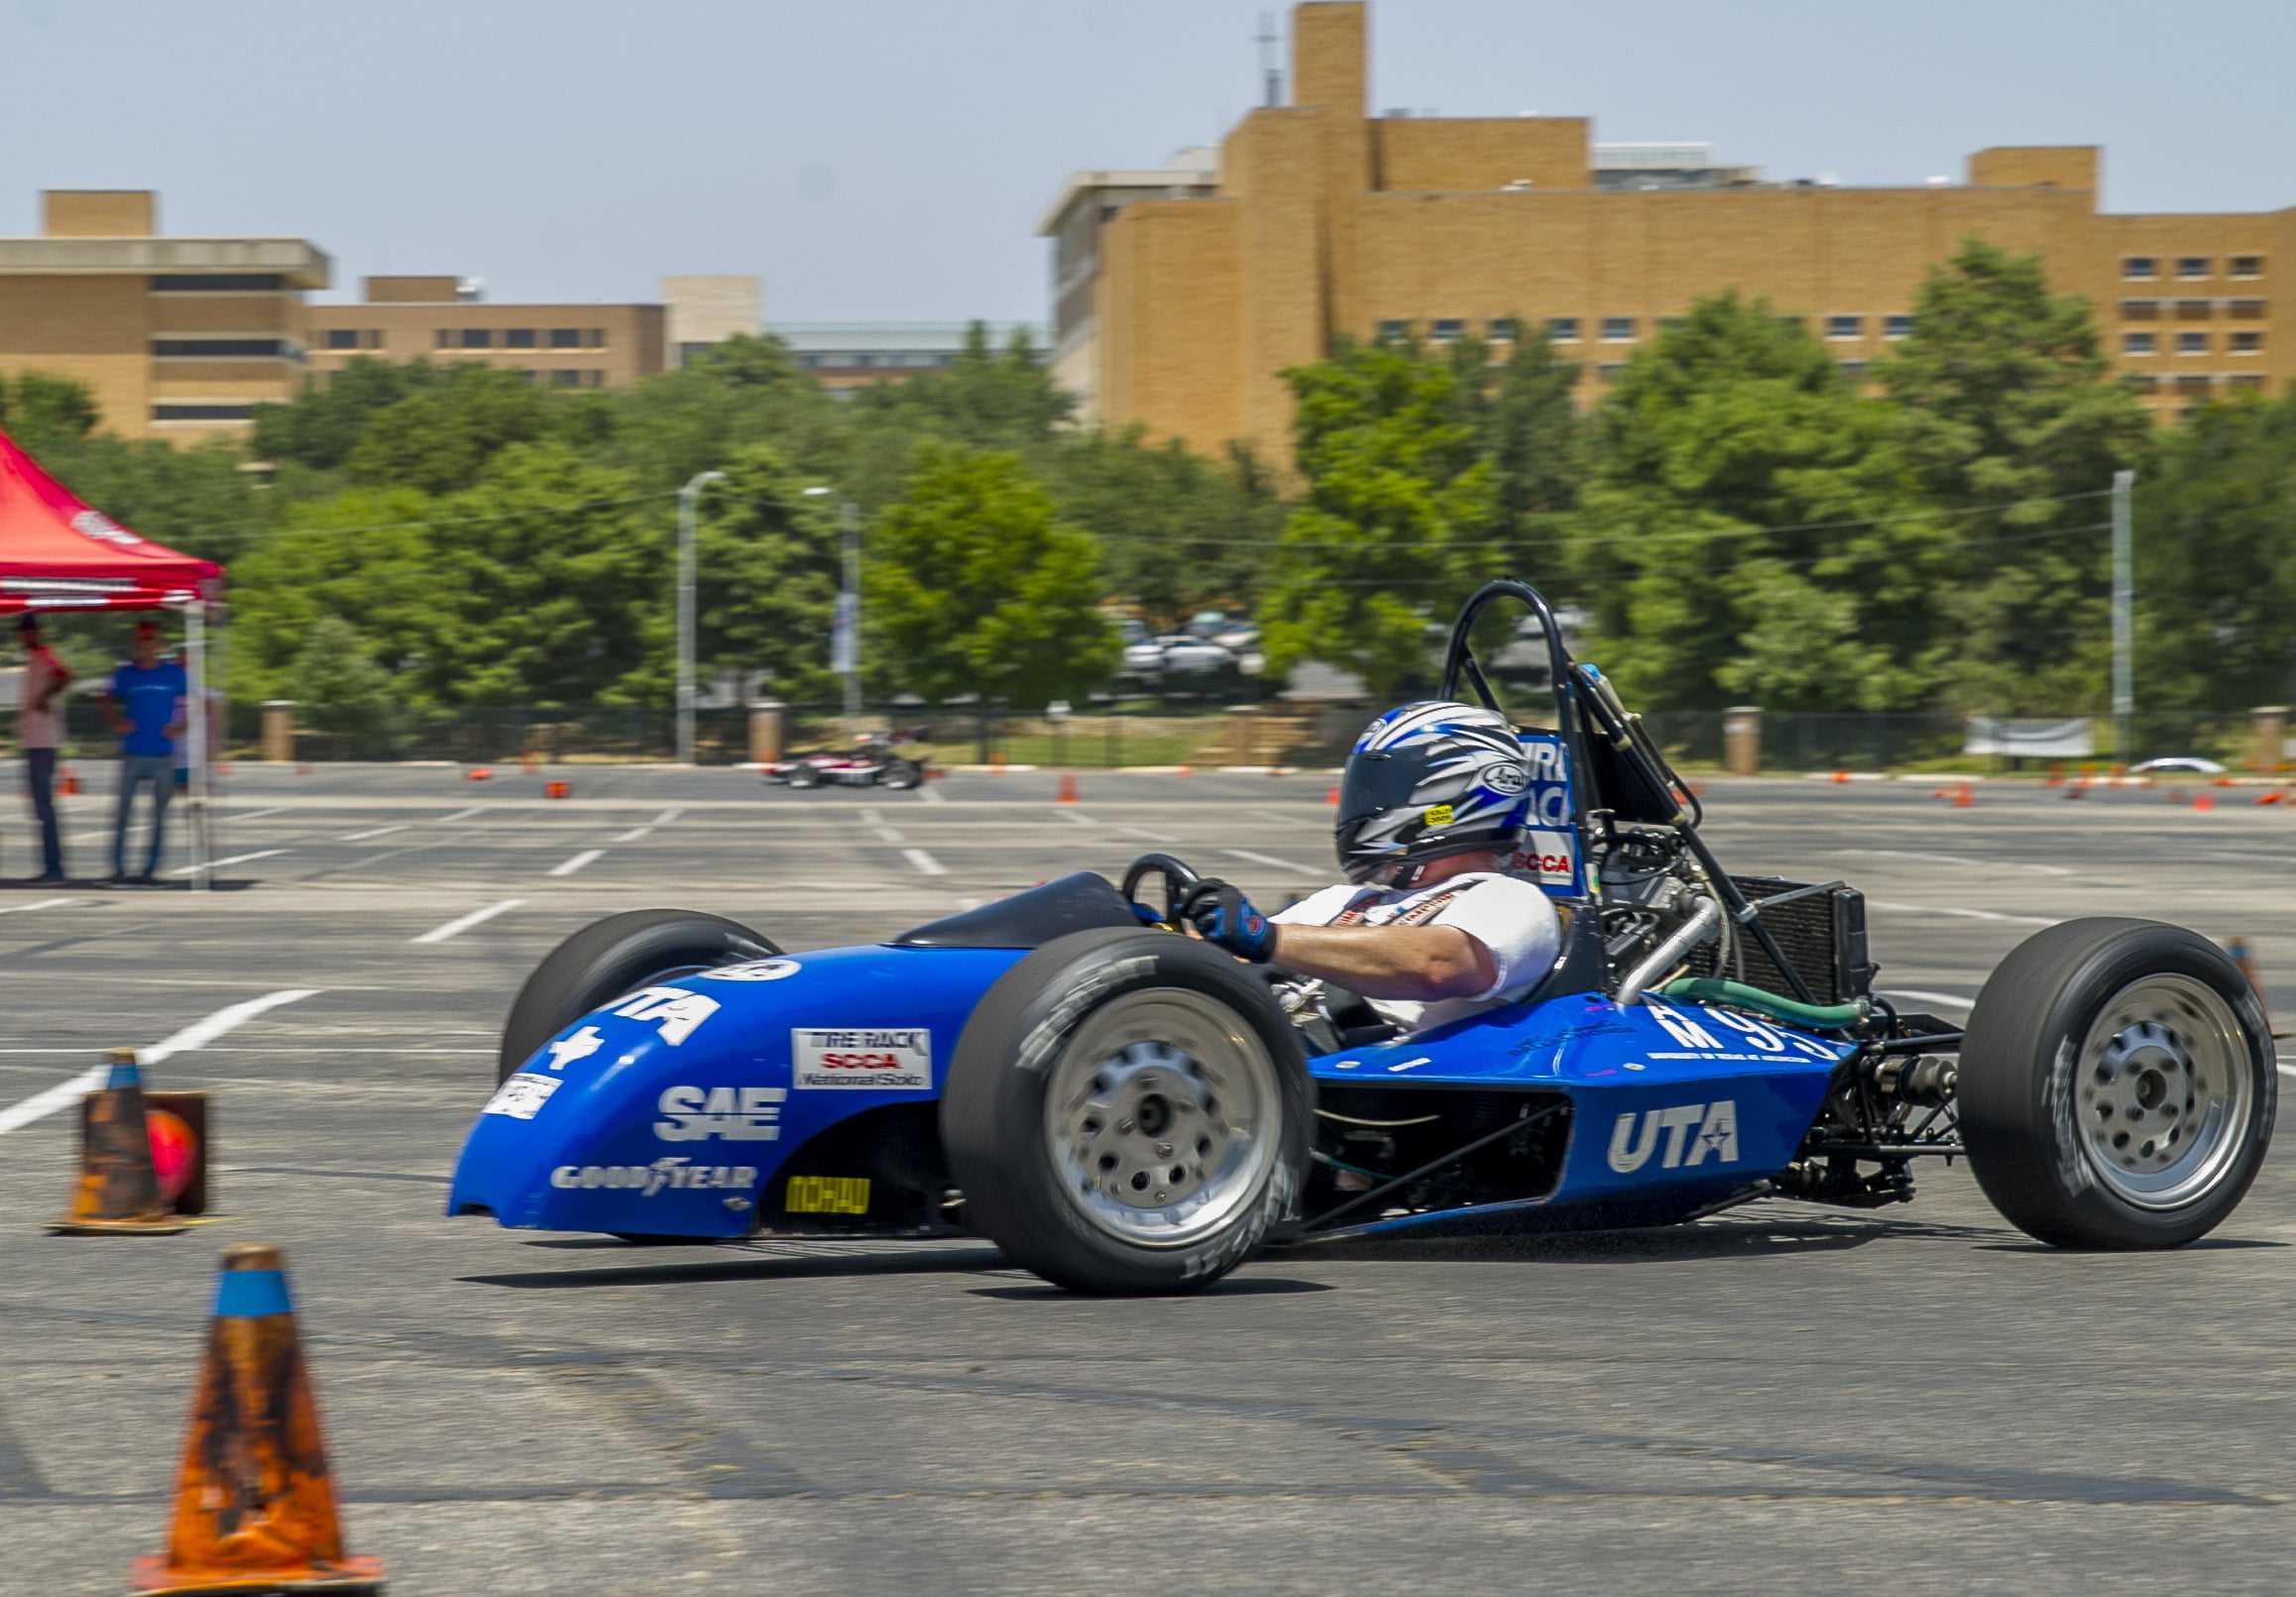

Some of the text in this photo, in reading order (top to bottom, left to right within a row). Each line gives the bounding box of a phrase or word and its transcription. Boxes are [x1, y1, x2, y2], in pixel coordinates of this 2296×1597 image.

[1512, 853, 1571, 873] SCCA
[862, 1032, 928, 1056] RACK
[820, 1053, 904, 1069] SCCA
[653, 1085, 787, 1142] SAE
[1607, 1099, 1739, 1173] UTA
[550, 1161, 758, 1193] GOODYEAR
